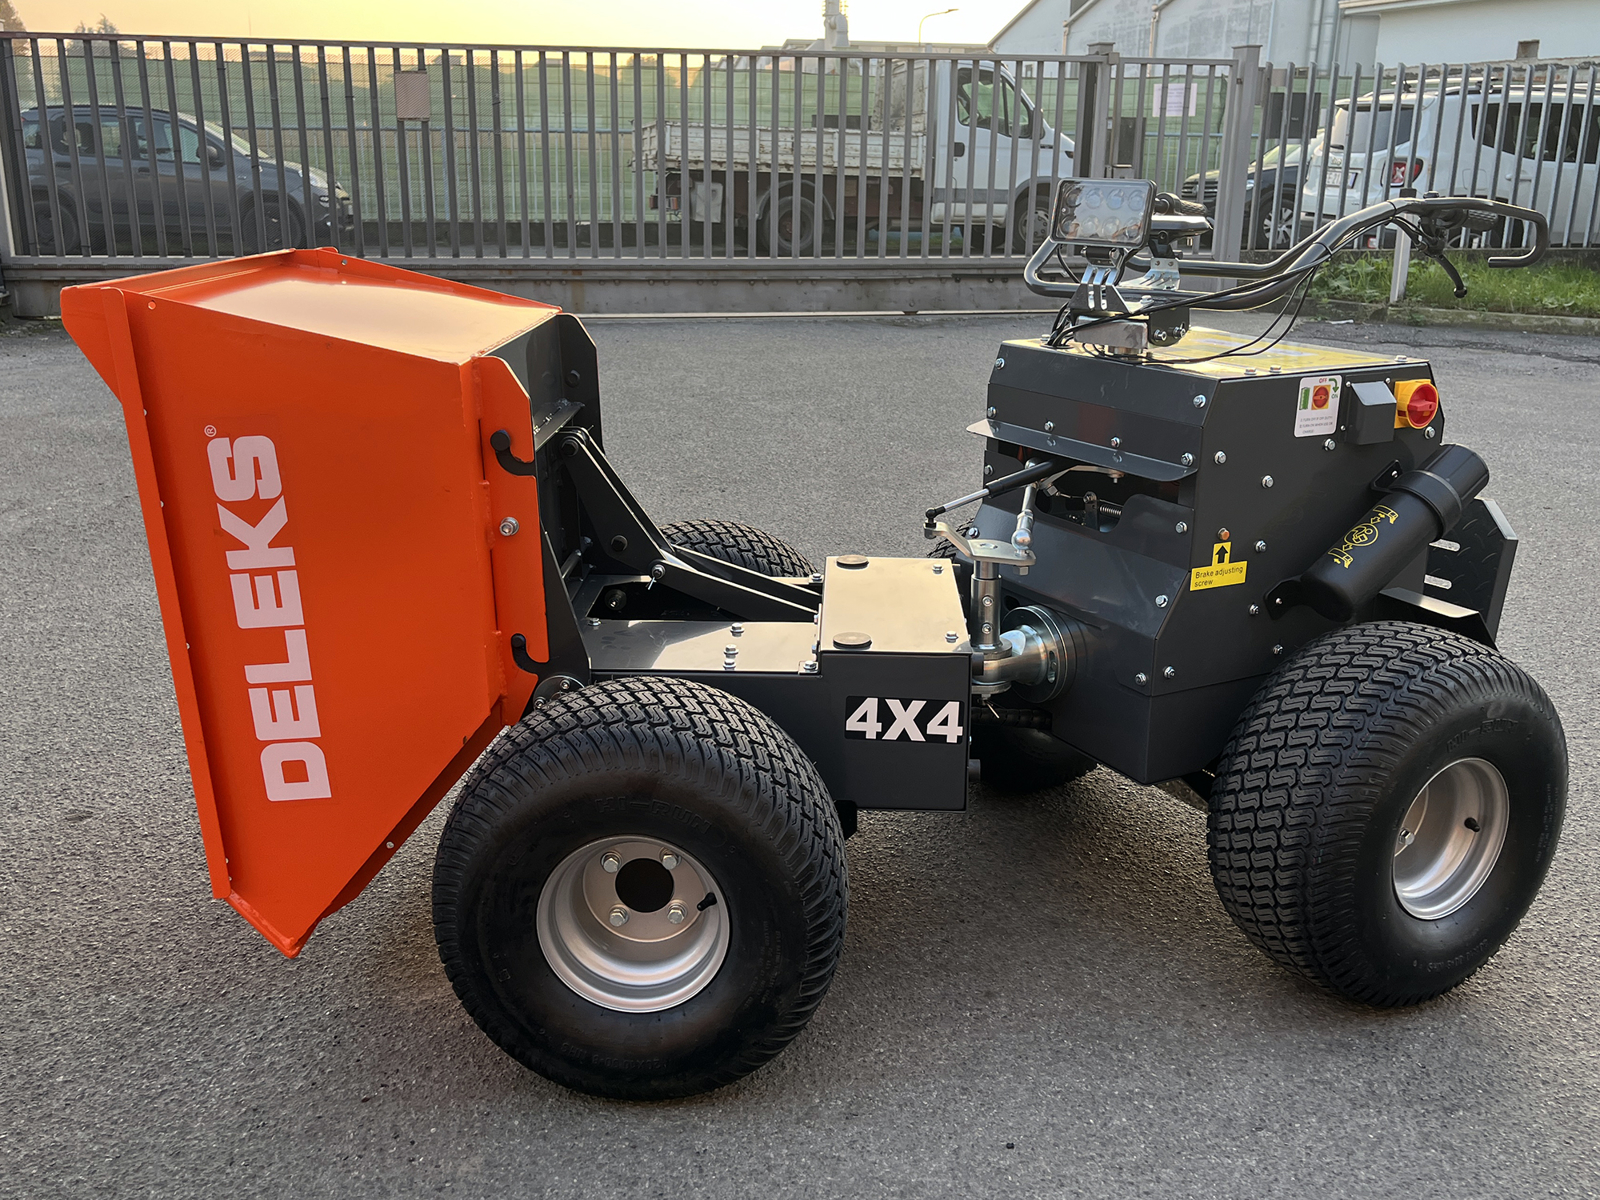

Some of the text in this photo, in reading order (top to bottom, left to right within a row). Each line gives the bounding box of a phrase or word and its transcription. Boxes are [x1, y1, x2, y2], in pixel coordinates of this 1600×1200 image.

[1194, 579, 1213, 587] screw
[1195, 566, 1244, 579] Brake adjusting
[206, 434, 332, 802] DELEKS
[845, 697, 963, 744] 4X4
[594, 796, 712, 835] HI-RUN
